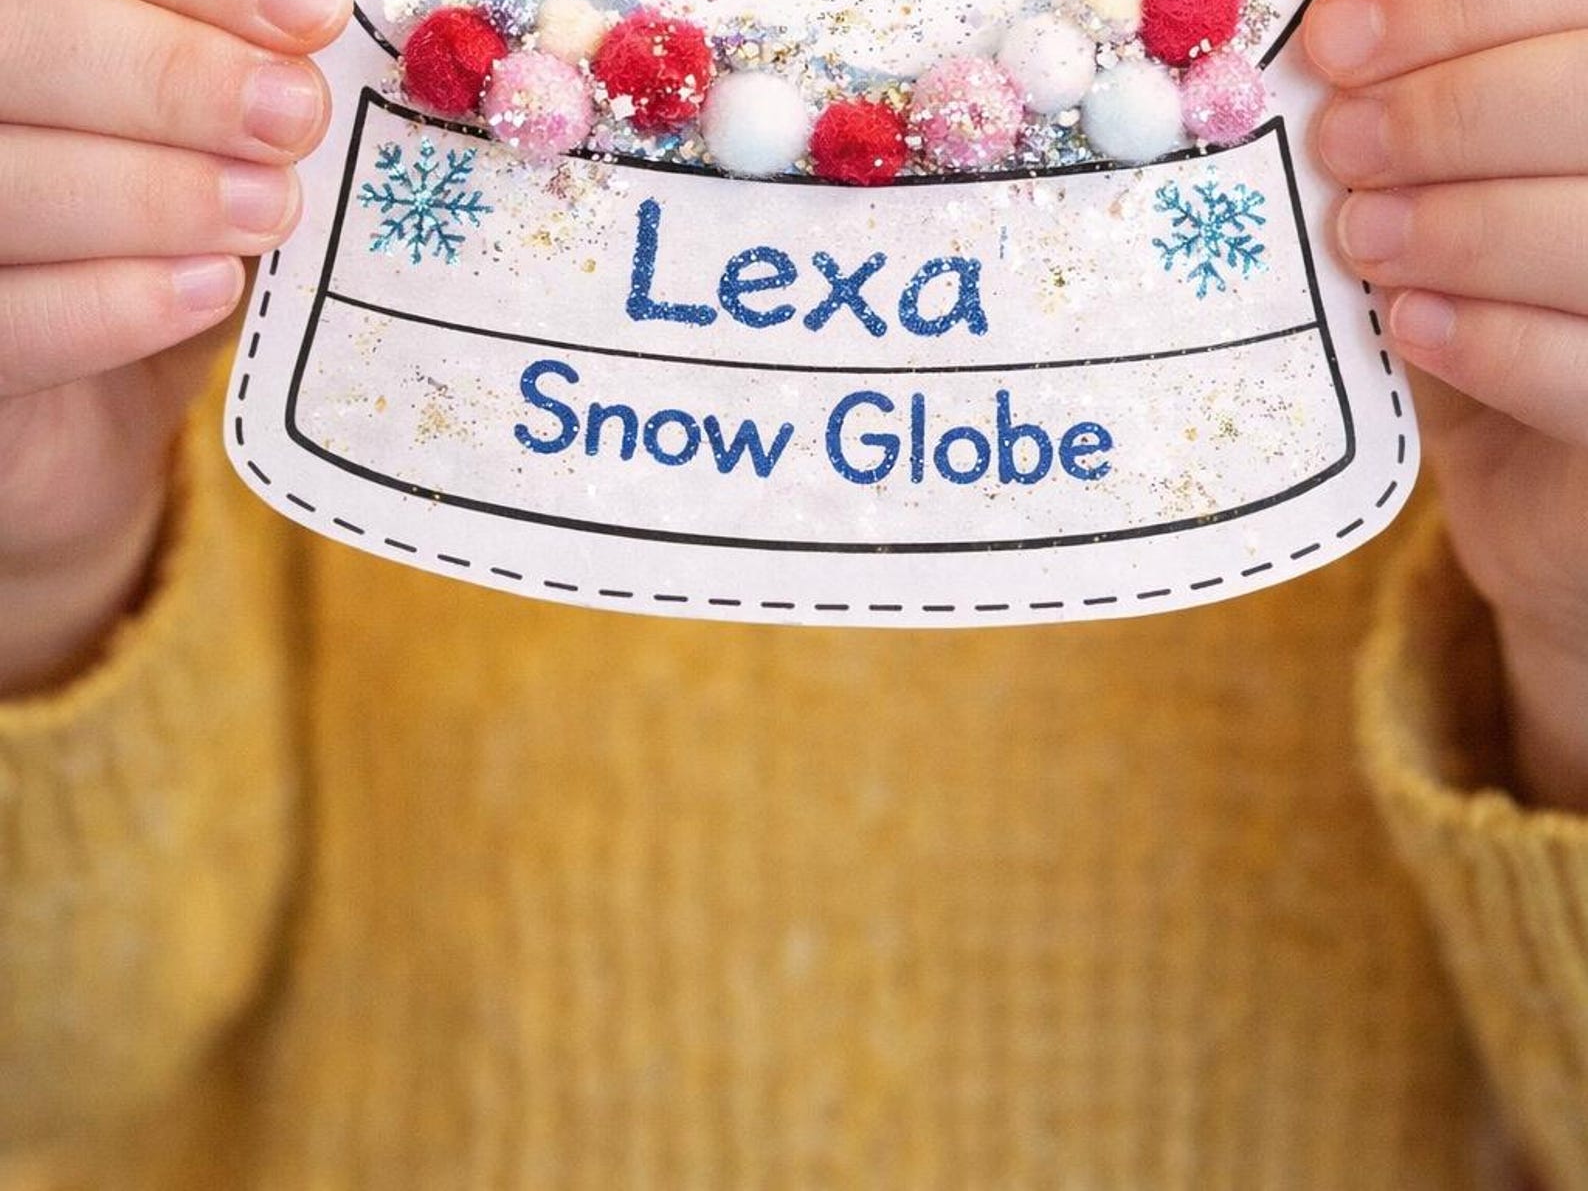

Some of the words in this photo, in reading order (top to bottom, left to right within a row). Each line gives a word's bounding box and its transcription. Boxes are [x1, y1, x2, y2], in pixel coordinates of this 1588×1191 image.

[626, 198, 988, 338] Lexa
[514, 359, 794, 478] Snow
[825, 389, 1114, 486] Globe
